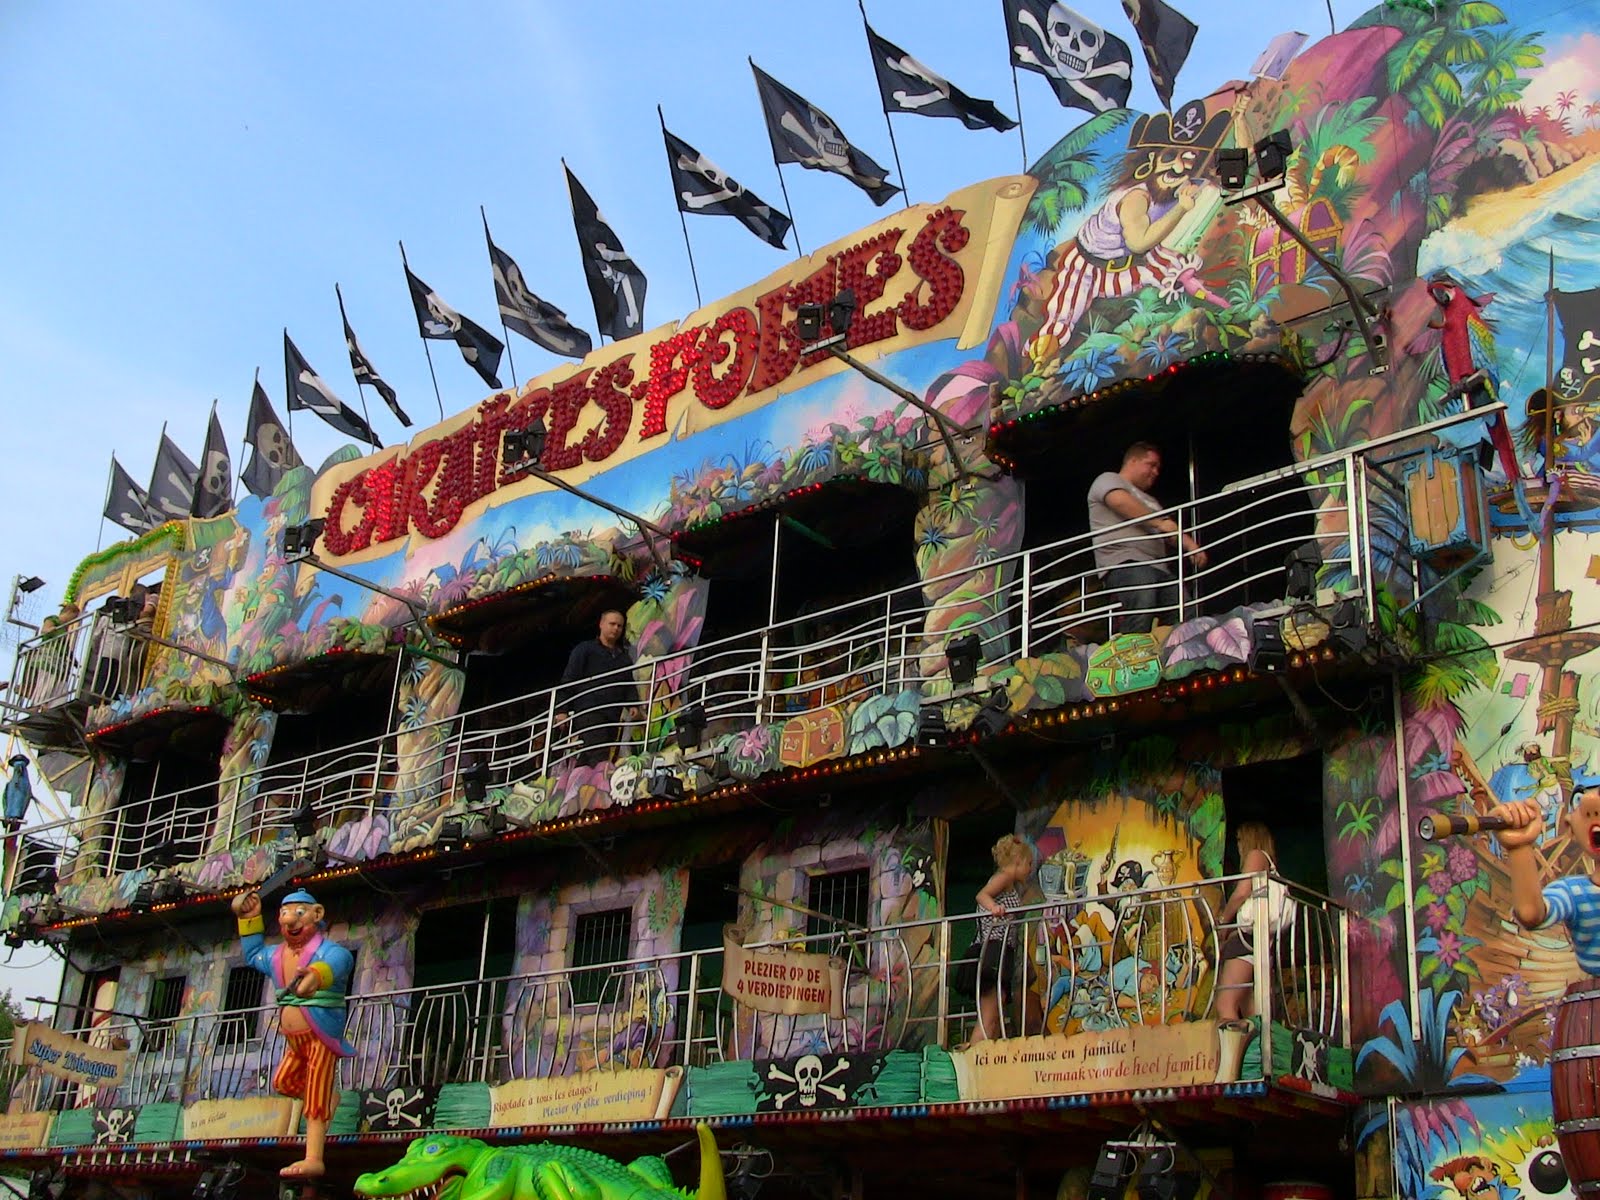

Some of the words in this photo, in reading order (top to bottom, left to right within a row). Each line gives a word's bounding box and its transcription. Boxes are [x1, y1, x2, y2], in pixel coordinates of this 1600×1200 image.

[744, 960, 787, 981] PLEZIER
[789, 966, 804, 982] OP
[807, 968, 821, 983] DE
[737, 979, 745, 994] 4
[747, 980, 825, 1003] VERDIEPINGEN
[28, 1038, 62, 1067] Super
[63, 1050, 117, 1083] Toboggan
[975, 1053, 989, 1066] Ici
[993, 1053, 1008, 1065] on
[1012, 1049, 1057, 1064] s'amuse
[1061, 1049, 1076, 1060] en
[1081, 1040, 1127, 1063] famille
[1034, 1066, 1086, 1084] Vermaak
[1132, 1056, 1160, 1076] heel
[554, 1089, 566, 1101] les
[572, 1101, 582, 1115] op
